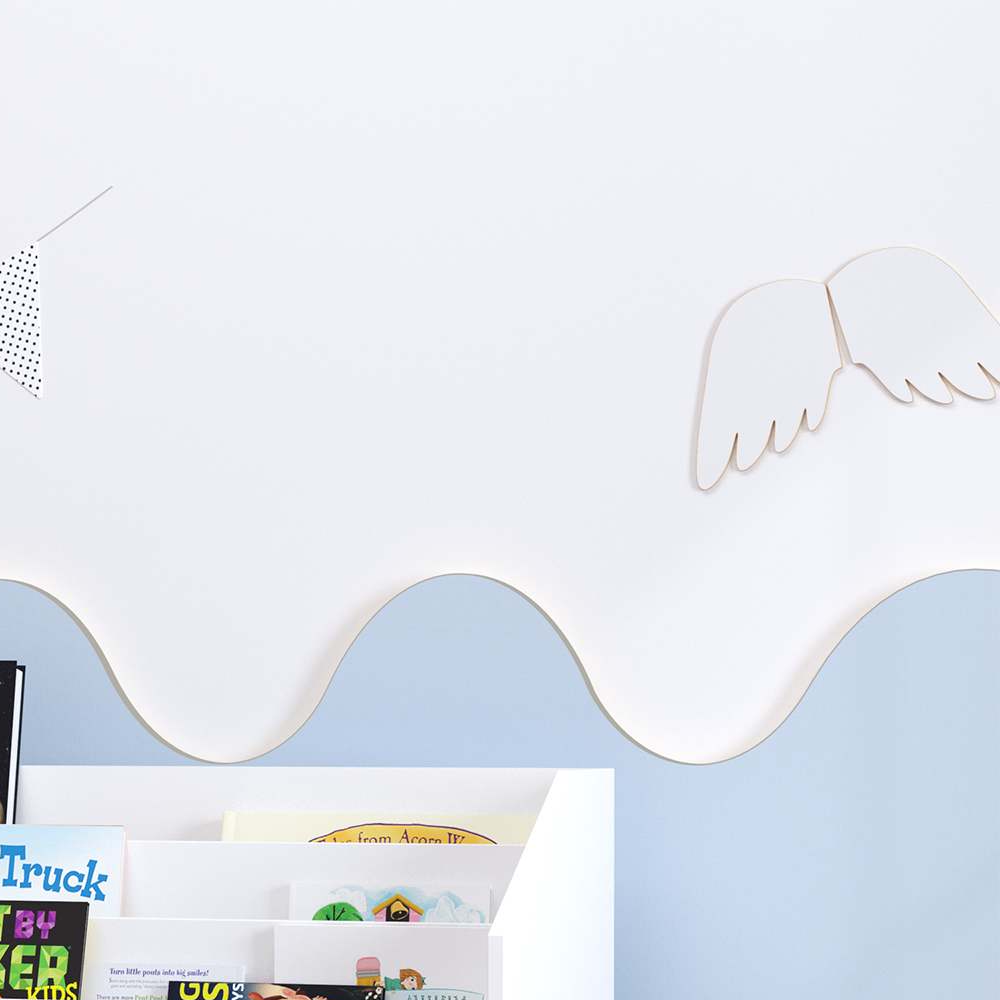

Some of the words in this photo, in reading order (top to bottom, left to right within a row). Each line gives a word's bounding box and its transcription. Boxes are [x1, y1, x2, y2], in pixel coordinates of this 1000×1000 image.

[358, 831, 391, 843] from
[399, 828, 442, 844] Acorn
[0, 844, 109, 901] Truck
[14, 910, 57, 940] BY
[110, 968, 125, 976] Turn
[126, 967, 141, 976] little
[142, 969, 161, 978] pouts
[26, 981, 78, 1000] KIDS
